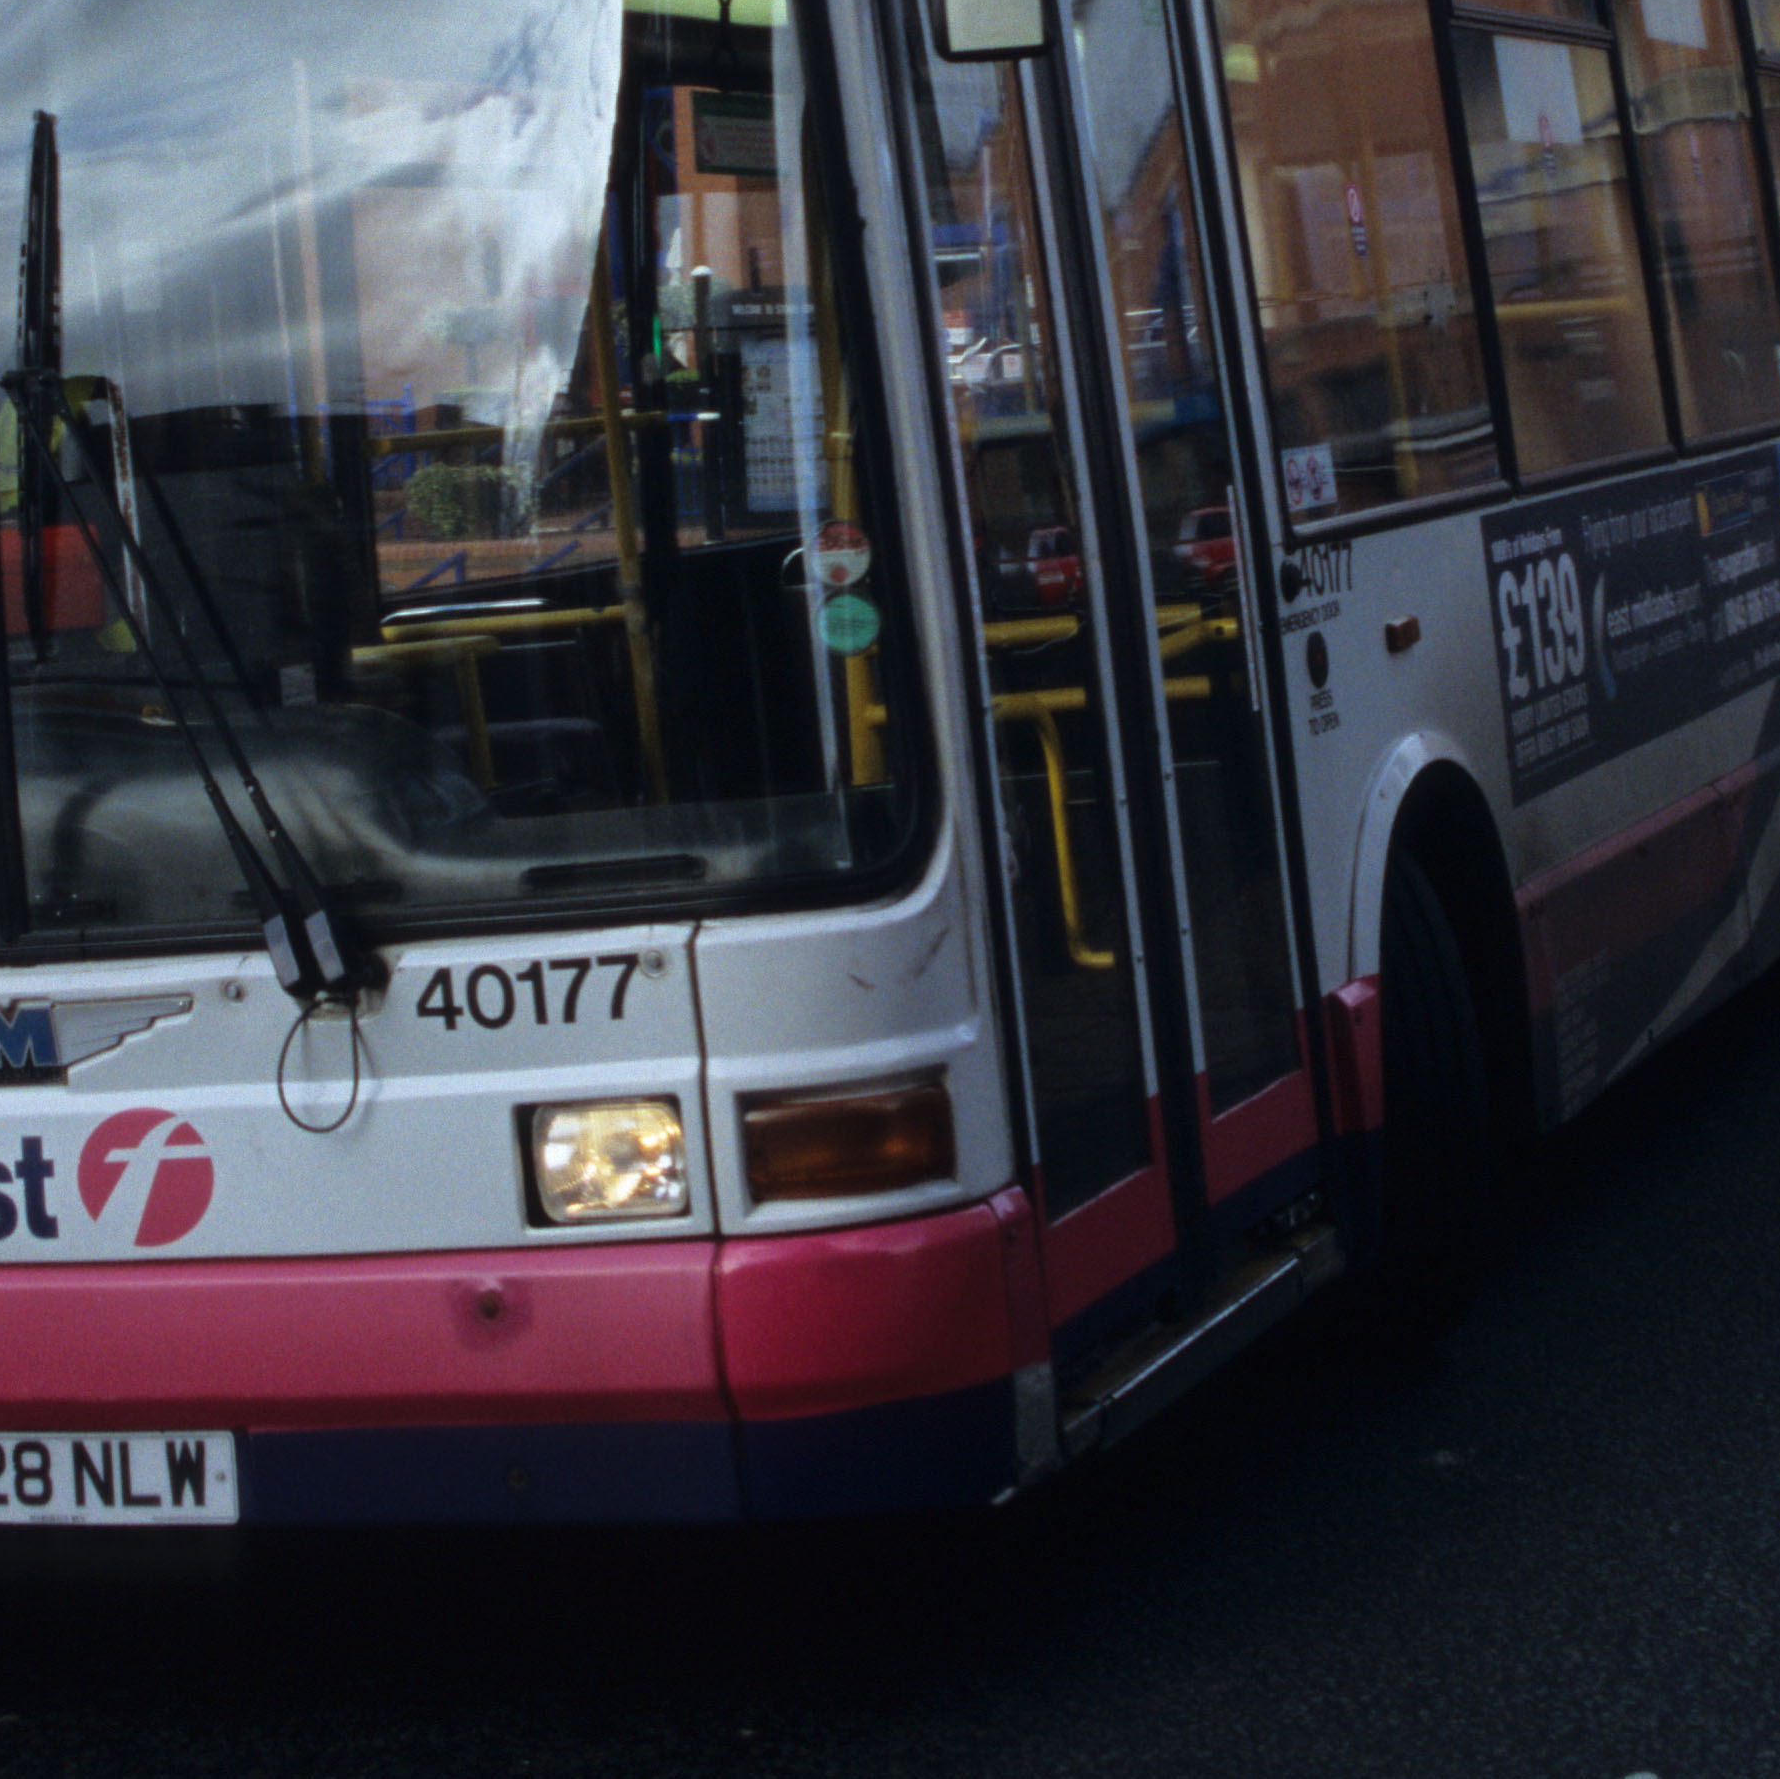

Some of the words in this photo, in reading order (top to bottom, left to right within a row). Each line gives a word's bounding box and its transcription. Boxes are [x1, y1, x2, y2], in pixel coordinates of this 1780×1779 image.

[1498, 552, 1585, 701] £139
[1607, 601, 1630, 638] east
[416, 954, 641, 1033] 40177
[72, 1440, 207, 1507] NLW
